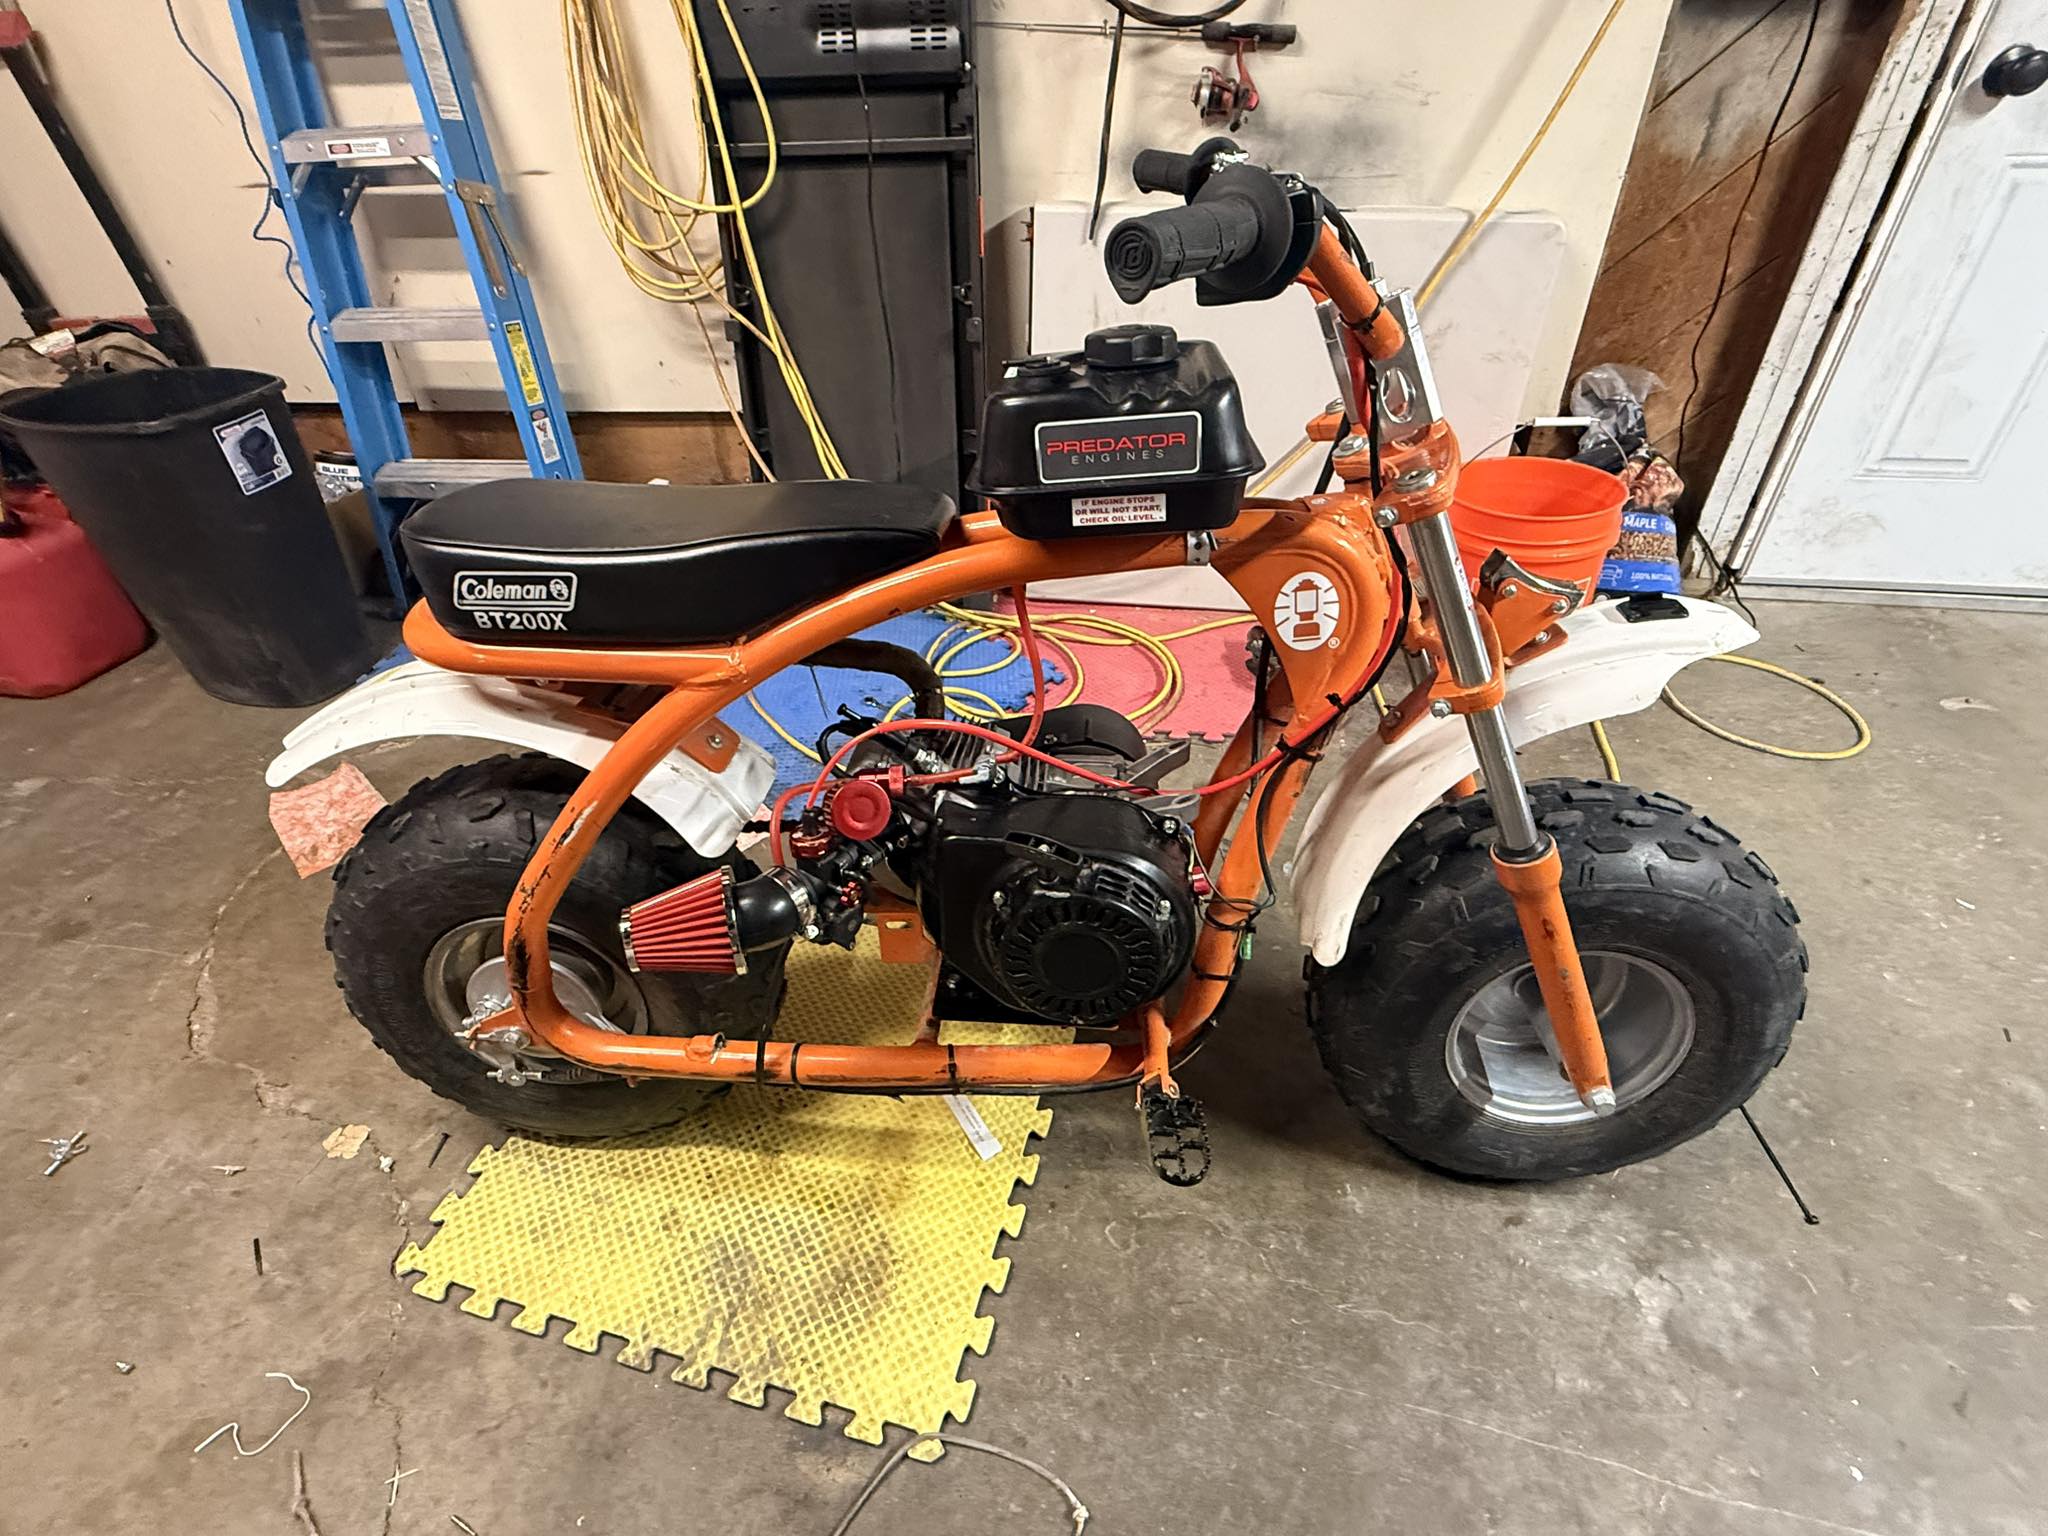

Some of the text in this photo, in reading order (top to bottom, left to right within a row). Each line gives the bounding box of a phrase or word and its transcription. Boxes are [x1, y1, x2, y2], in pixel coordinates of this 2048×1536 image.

[1047, 432, 1186, 455] PREDATOR
[1071, 449, 1165, 465] ENGINES
[322, 466, 349, 474] BLUE
[1092, 498, 1125, 506] ENGINE
[1126, 496, 1155, 504] STOPS
[1075, 504, 1162, 516] OR WILL NOT START,
[1079, 516, 1109, 524] CHECK
[1111, 515, 1126, 523] OIL
[1623, 515, 1657, 529] MAPLE
[461, 578, 547, 599] Coleman
[473, 611, 568, 631] BT200X
